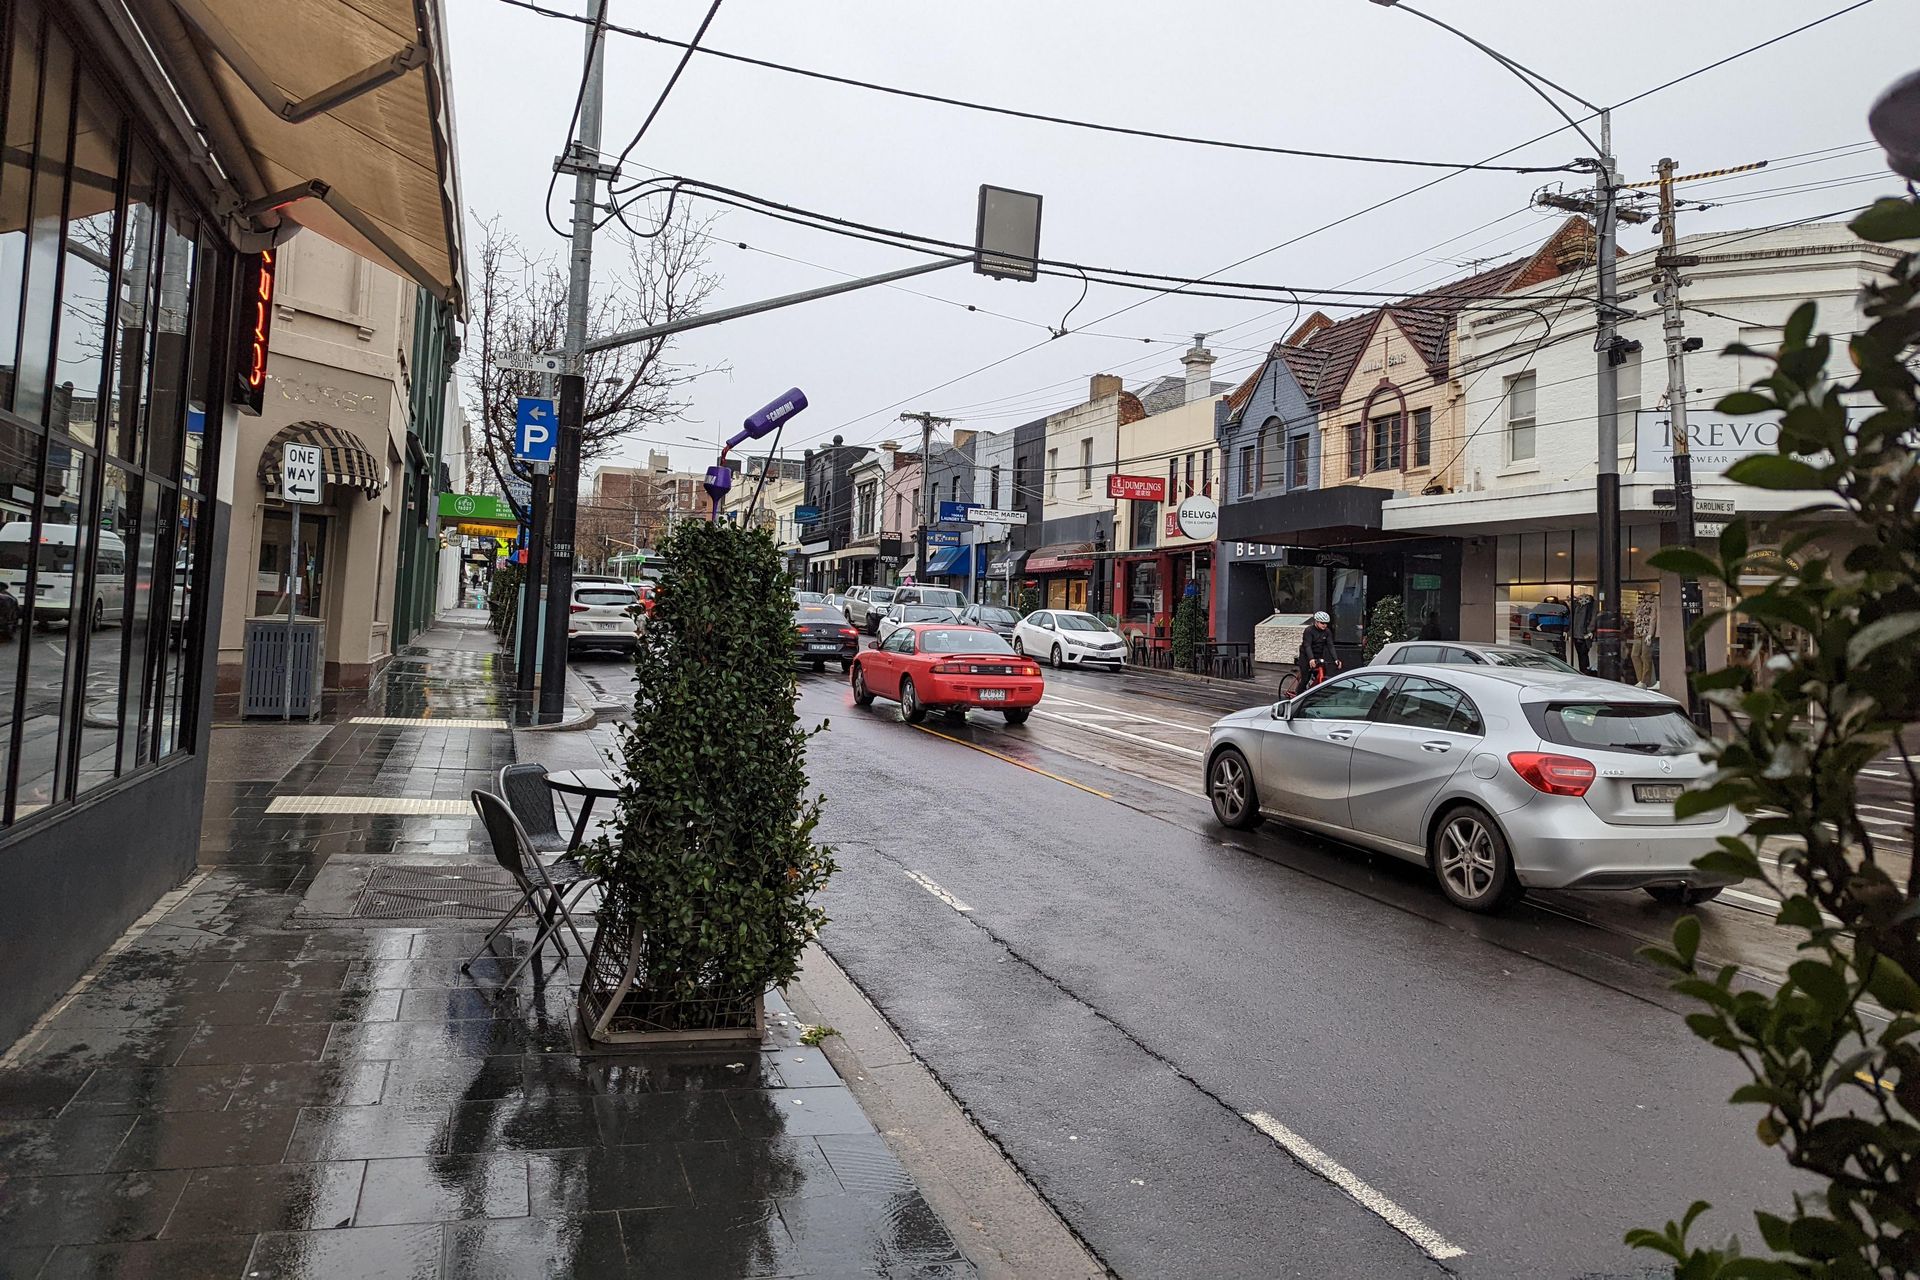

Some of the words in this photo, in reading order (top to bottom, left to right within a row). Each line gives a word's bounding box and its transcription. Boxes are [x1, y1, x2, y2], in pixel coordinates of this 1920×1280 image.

[498, 352, 534, 363] CAROLINE
[536, 356, 545, 364] ST
[510, 360, 533, 369] SOUTH
[523, 424, 549, 453] P
[1655, 420, 1779, 447] TREVO
[289, 449, 315, 465] ONE
[1663, 456, 1728, 464] MSWEAR
[287, 466, 316, 482] WAY
[1125, 481, 1162, 491] DUMPLINGS
[1695, 501, 1725, 511] CAROLINE
[1726, 503, 1734, 511] ST
[969, 509, 999, 517] FREDRIC
[1001, 511, 1026, 519] MARCH
[1181, 510, 1218, 519] BELVGA
[1236, 542, 1278, 557] BELV
